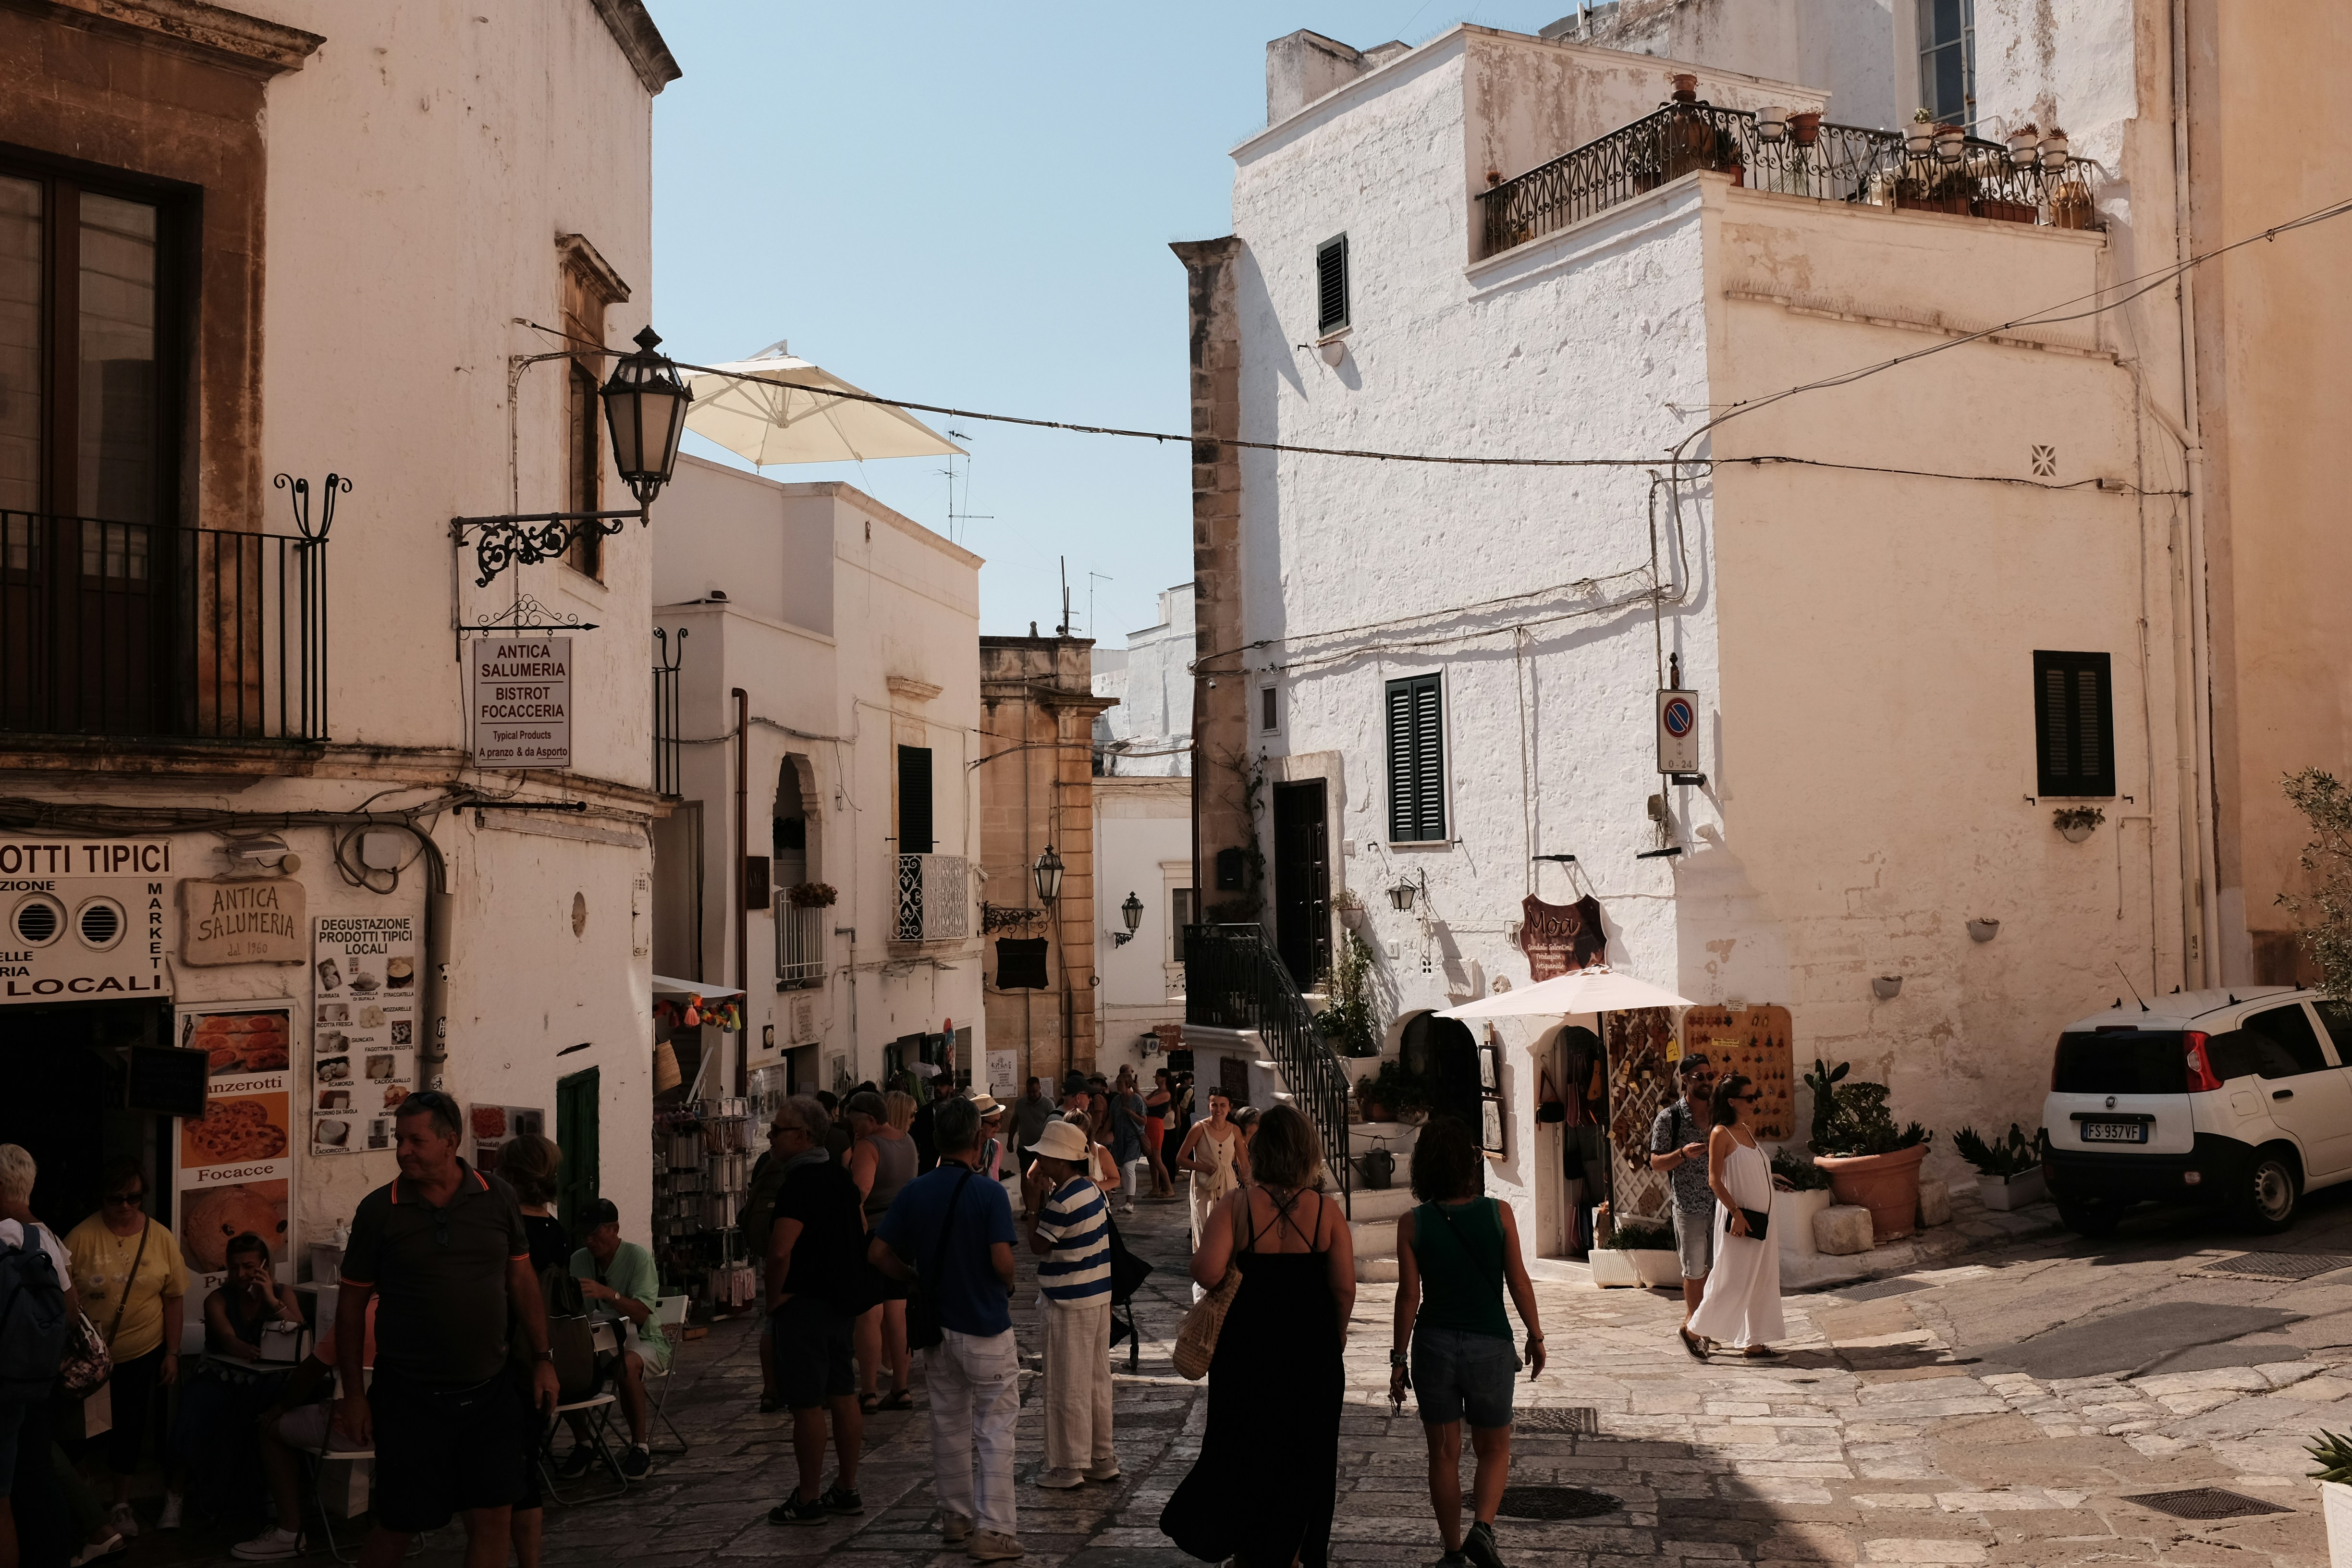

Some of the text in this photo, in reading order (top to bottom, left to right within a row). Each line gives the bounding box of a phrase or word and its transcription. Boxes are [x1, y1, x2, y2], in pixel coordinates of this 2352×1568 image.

[497, 645, 551, 658] ANTICA
[482, 663, 565, 677] SALUMERIA
[496, 687, 550, 700] BISTROT
[482, 704, 564, 718] FOCACCERIA
[493, 730, 551, 742] Typical Products
[479, 747, 567, 759] A pranzo & da Asporto
[1668, 760, 1674, 768] 0
[0, 845, 170, 874] OTTI TIPICI
[211, 886, 279, 915] ANTICA
[148, 883, 162, 968] MARKET
[197, 912, 294, 941] SALUMERIA
[322, 919, 410, 931] DEGUSTAZIONE
[1529, 911, 1580, 935] Moa
[319, 931, 412, 943] PRODOTTI TIPICI
[228, 942, 267, 956] dal 1960
[345, 943, 387, 955] LOCALI
[1391, 945, 1394, 954] 5
[7, 975, 160, 996] LOCALI
[208, 1076, 282, 1093] anzerotti
[197, 1165, 273, 1181] Focacce
